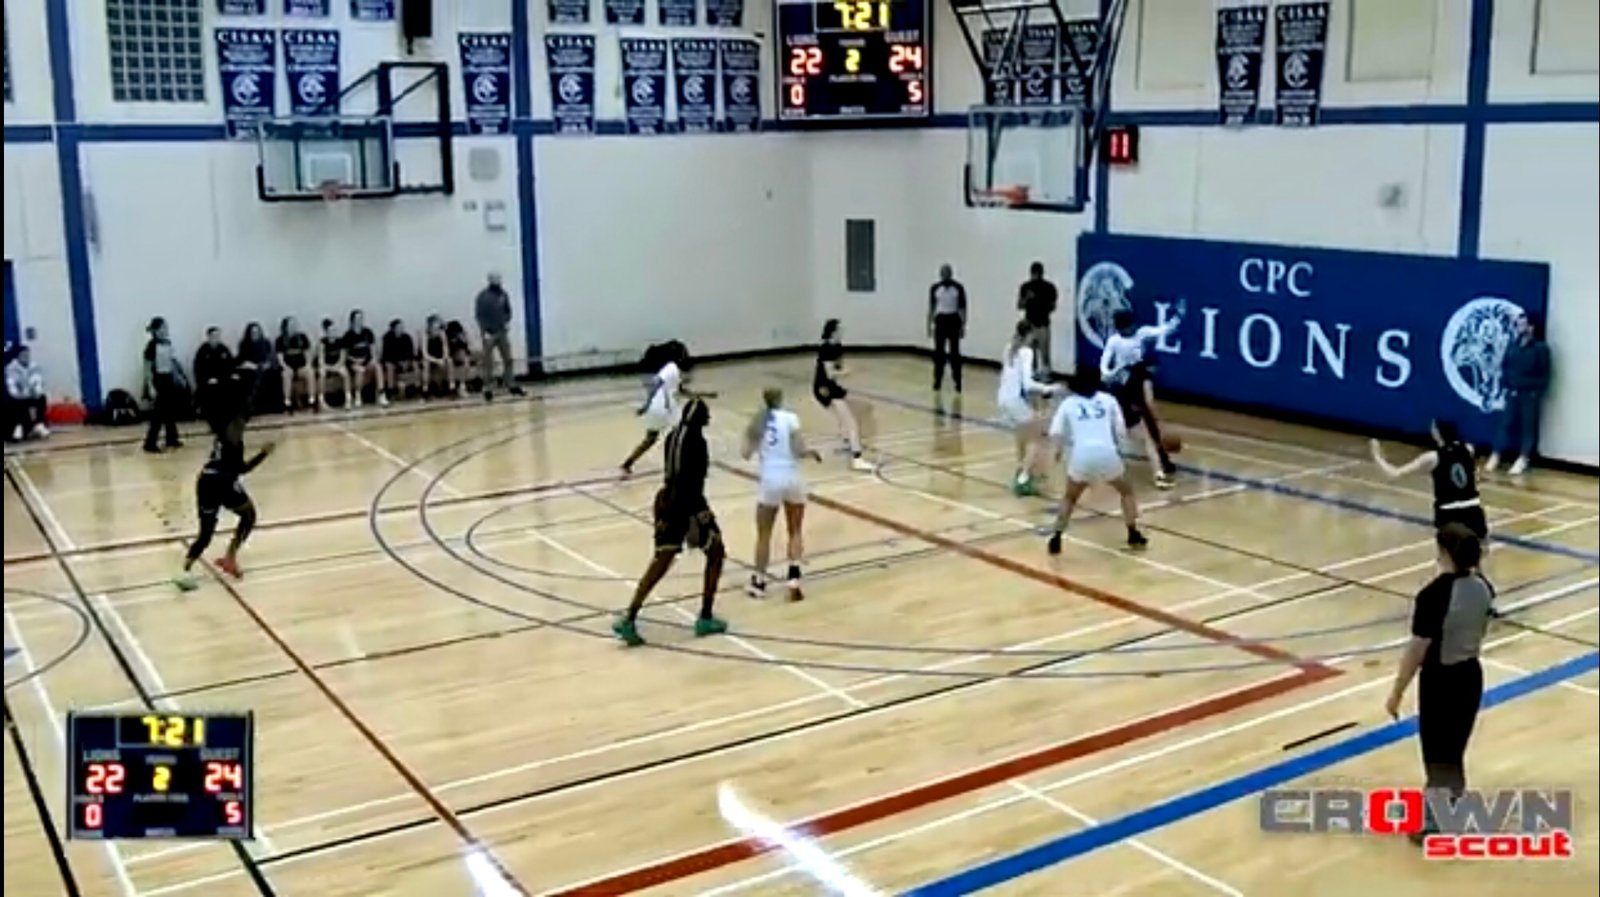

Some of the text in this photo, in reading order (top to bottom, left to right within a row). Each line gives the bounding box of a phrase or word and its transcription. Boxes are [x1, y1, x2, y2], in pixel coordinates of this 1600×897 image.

[833, 0, 889, 30] 7:21
[790, 47, 823, 74] 22
[845, 48, 861, 73] 2
[888, 44, 922, 73] 24
[790, 83, 804, 105] 0
[908, 80, 922, 103] 5
[1110, 132, 1128, 158] 11
[1238, 257, 1314, 298] CPC
[1154, 300, 1412, 388] LIONS
